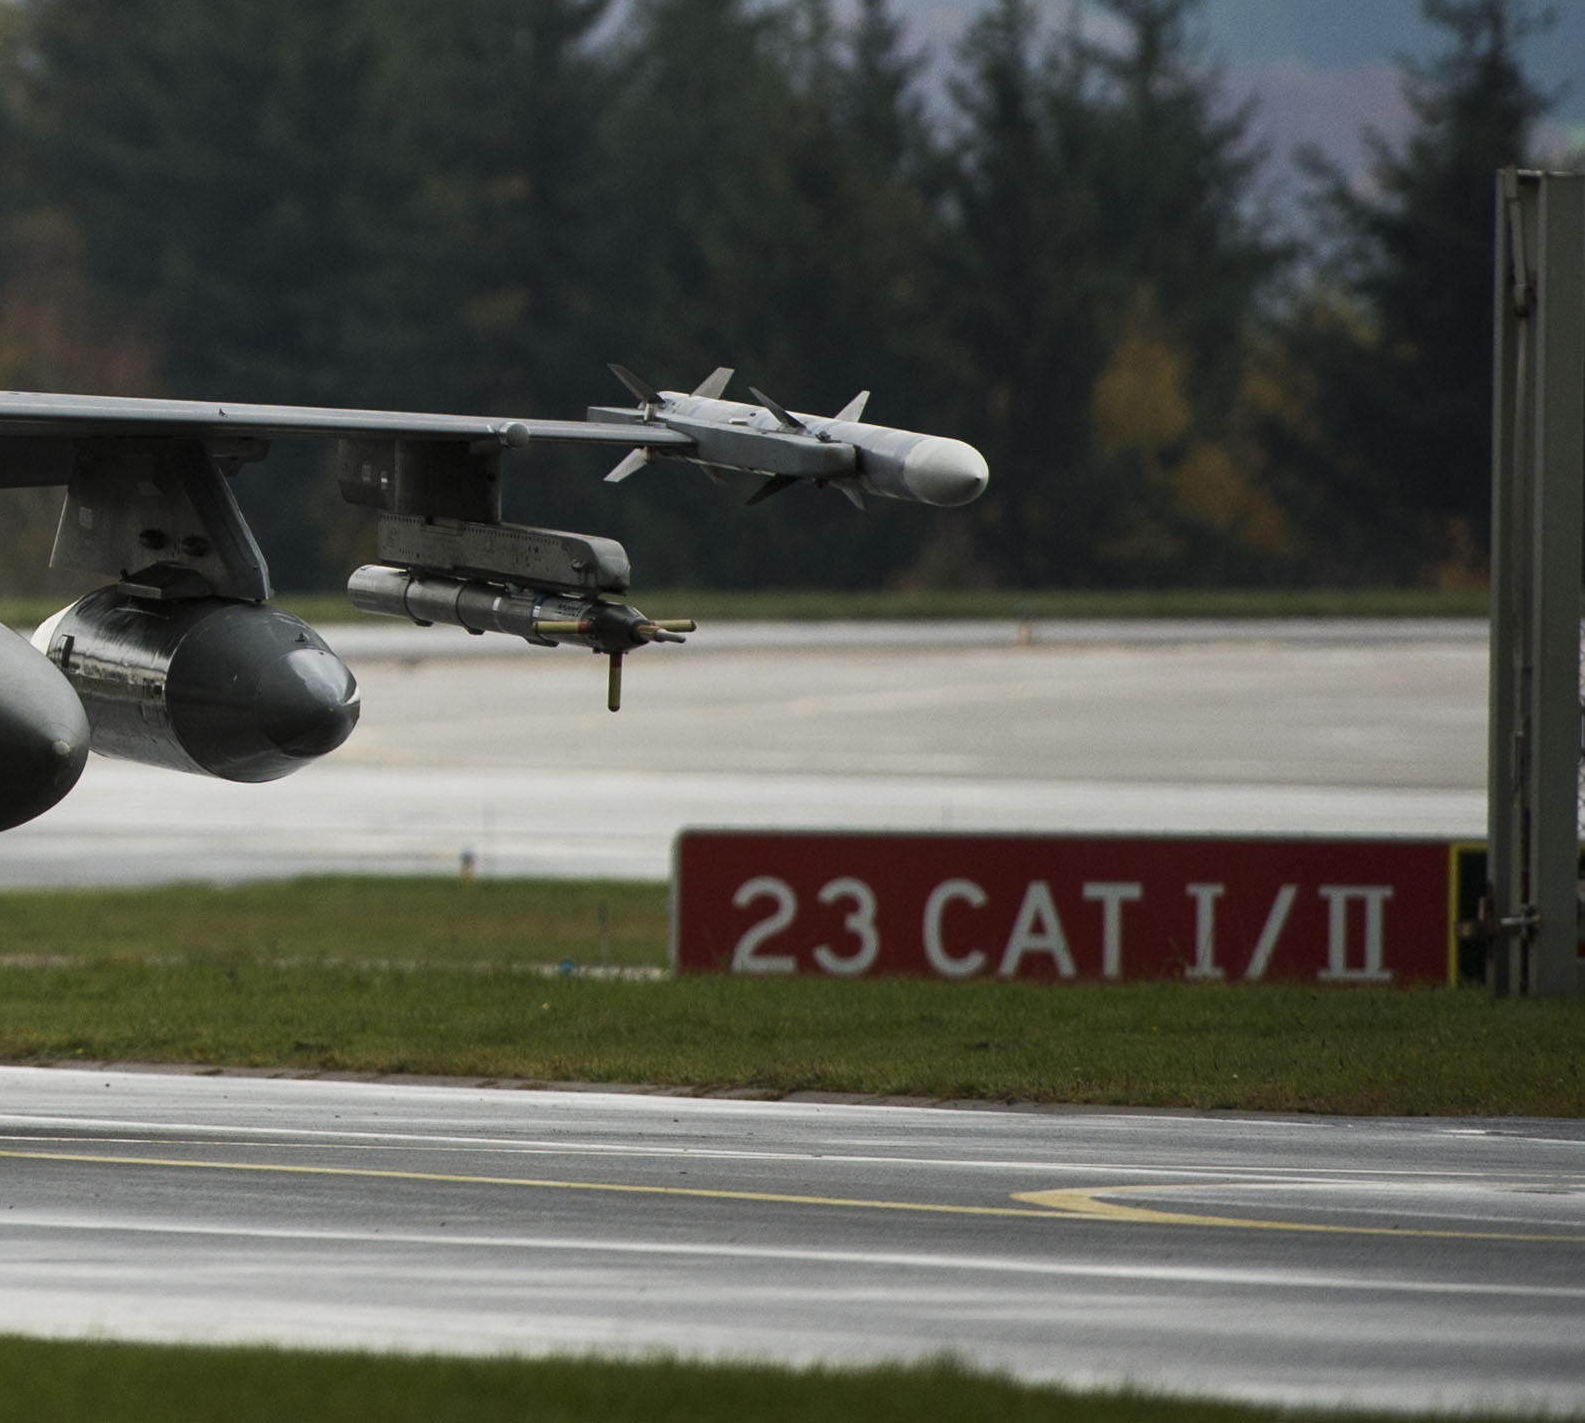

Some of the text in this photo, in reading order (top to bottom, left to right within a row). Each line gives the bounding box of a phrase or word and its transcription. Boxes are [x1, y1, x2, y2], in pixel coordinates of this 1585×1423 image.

[731, 875, 1395, 982] 23 CAT I/II
